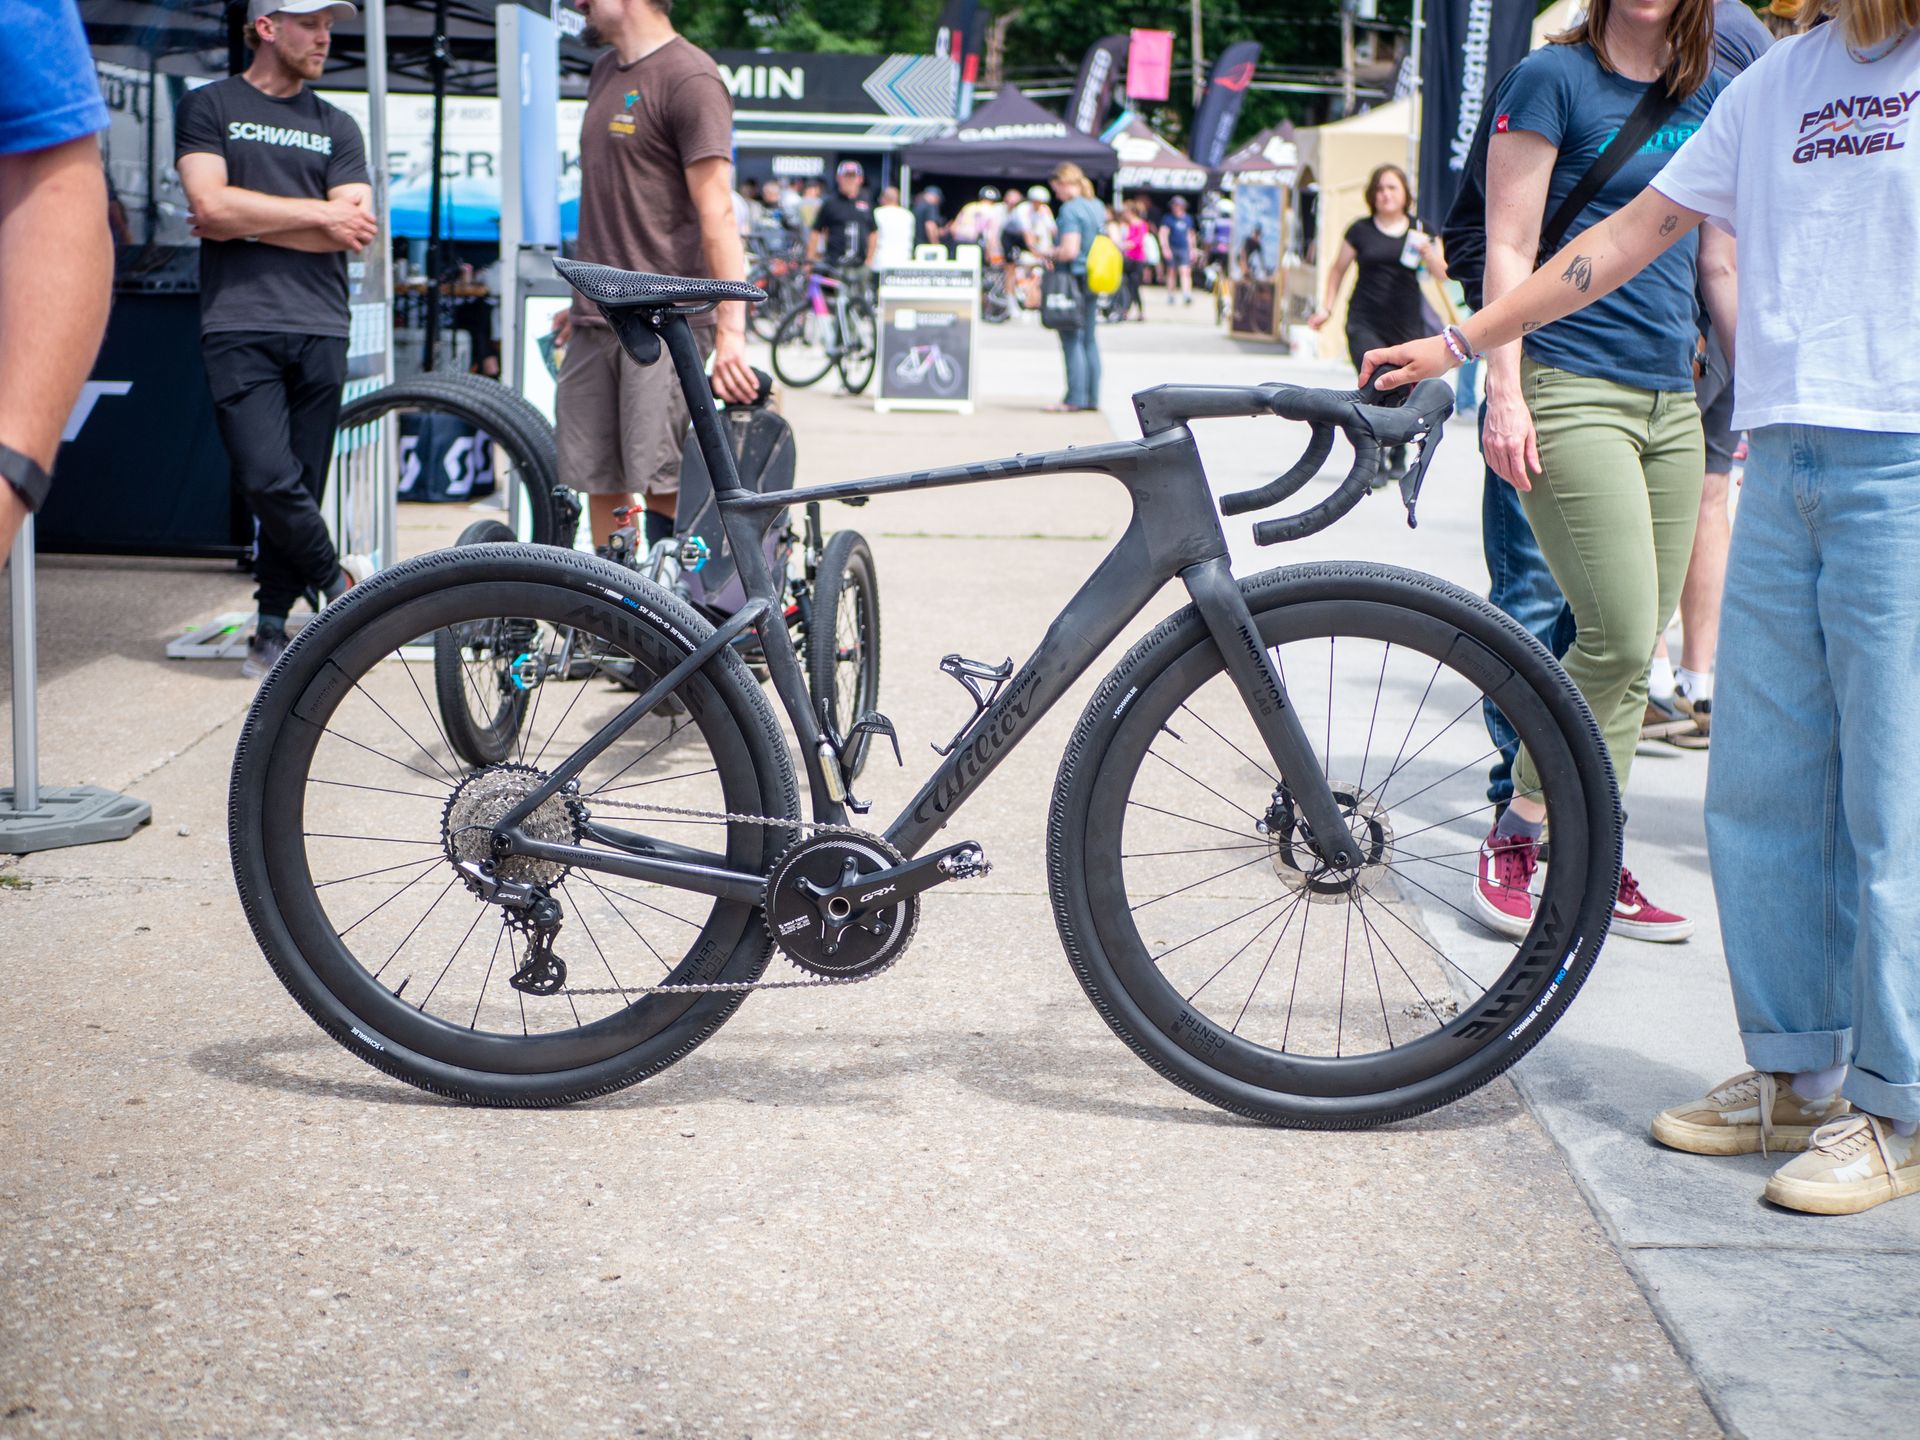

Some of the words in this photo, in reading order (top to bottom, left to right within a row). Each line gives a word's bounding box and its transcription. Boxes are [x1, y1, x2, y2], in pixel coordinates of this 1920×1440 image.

[718, 65, 805, 99] MIN
[1450, 0, 1493, 170] Momentum
[1799, 90, 1920, 134] FANTASY
[228, 121, 332, 156] SCHWALBE
[958, 122, 1068, 142] GARMIN
[1792, 132, 1905, 164] GRAVEL
[623, 597, 640, 609] PRO
[638, 605, 649, 614] RS
[647, 611, 670, 629] G-ONE
[670, 627, 697, 651] CHWALBE
[1236, 624, 1286, 711] INNOVATION
[993, 669, 1038, 722] TRIESTINA
[1114, 685, 1138, 716] SCHWALBE
[1252, 688, 1272, 717] LAB
[498, 892, 522, 901] GRX
[860, 883, 897, 903] GRX
[678, 939, 717, 986] CENTRE
[700, 948, 729, 981] TECH
[1451, 901, 1566, 1041] MICHE
[1511, 1010, 1538, 1038] SCHWALBE
[1535, 990, 1554, 1012] G-ONE
[1549, 982, 1559, 994] RS
[1555, 969, 1567, 985] PRO
[350, 1026, 381, 1050] SCHWALBE
[1179, 1010, 1226, 1049] CENTRE
